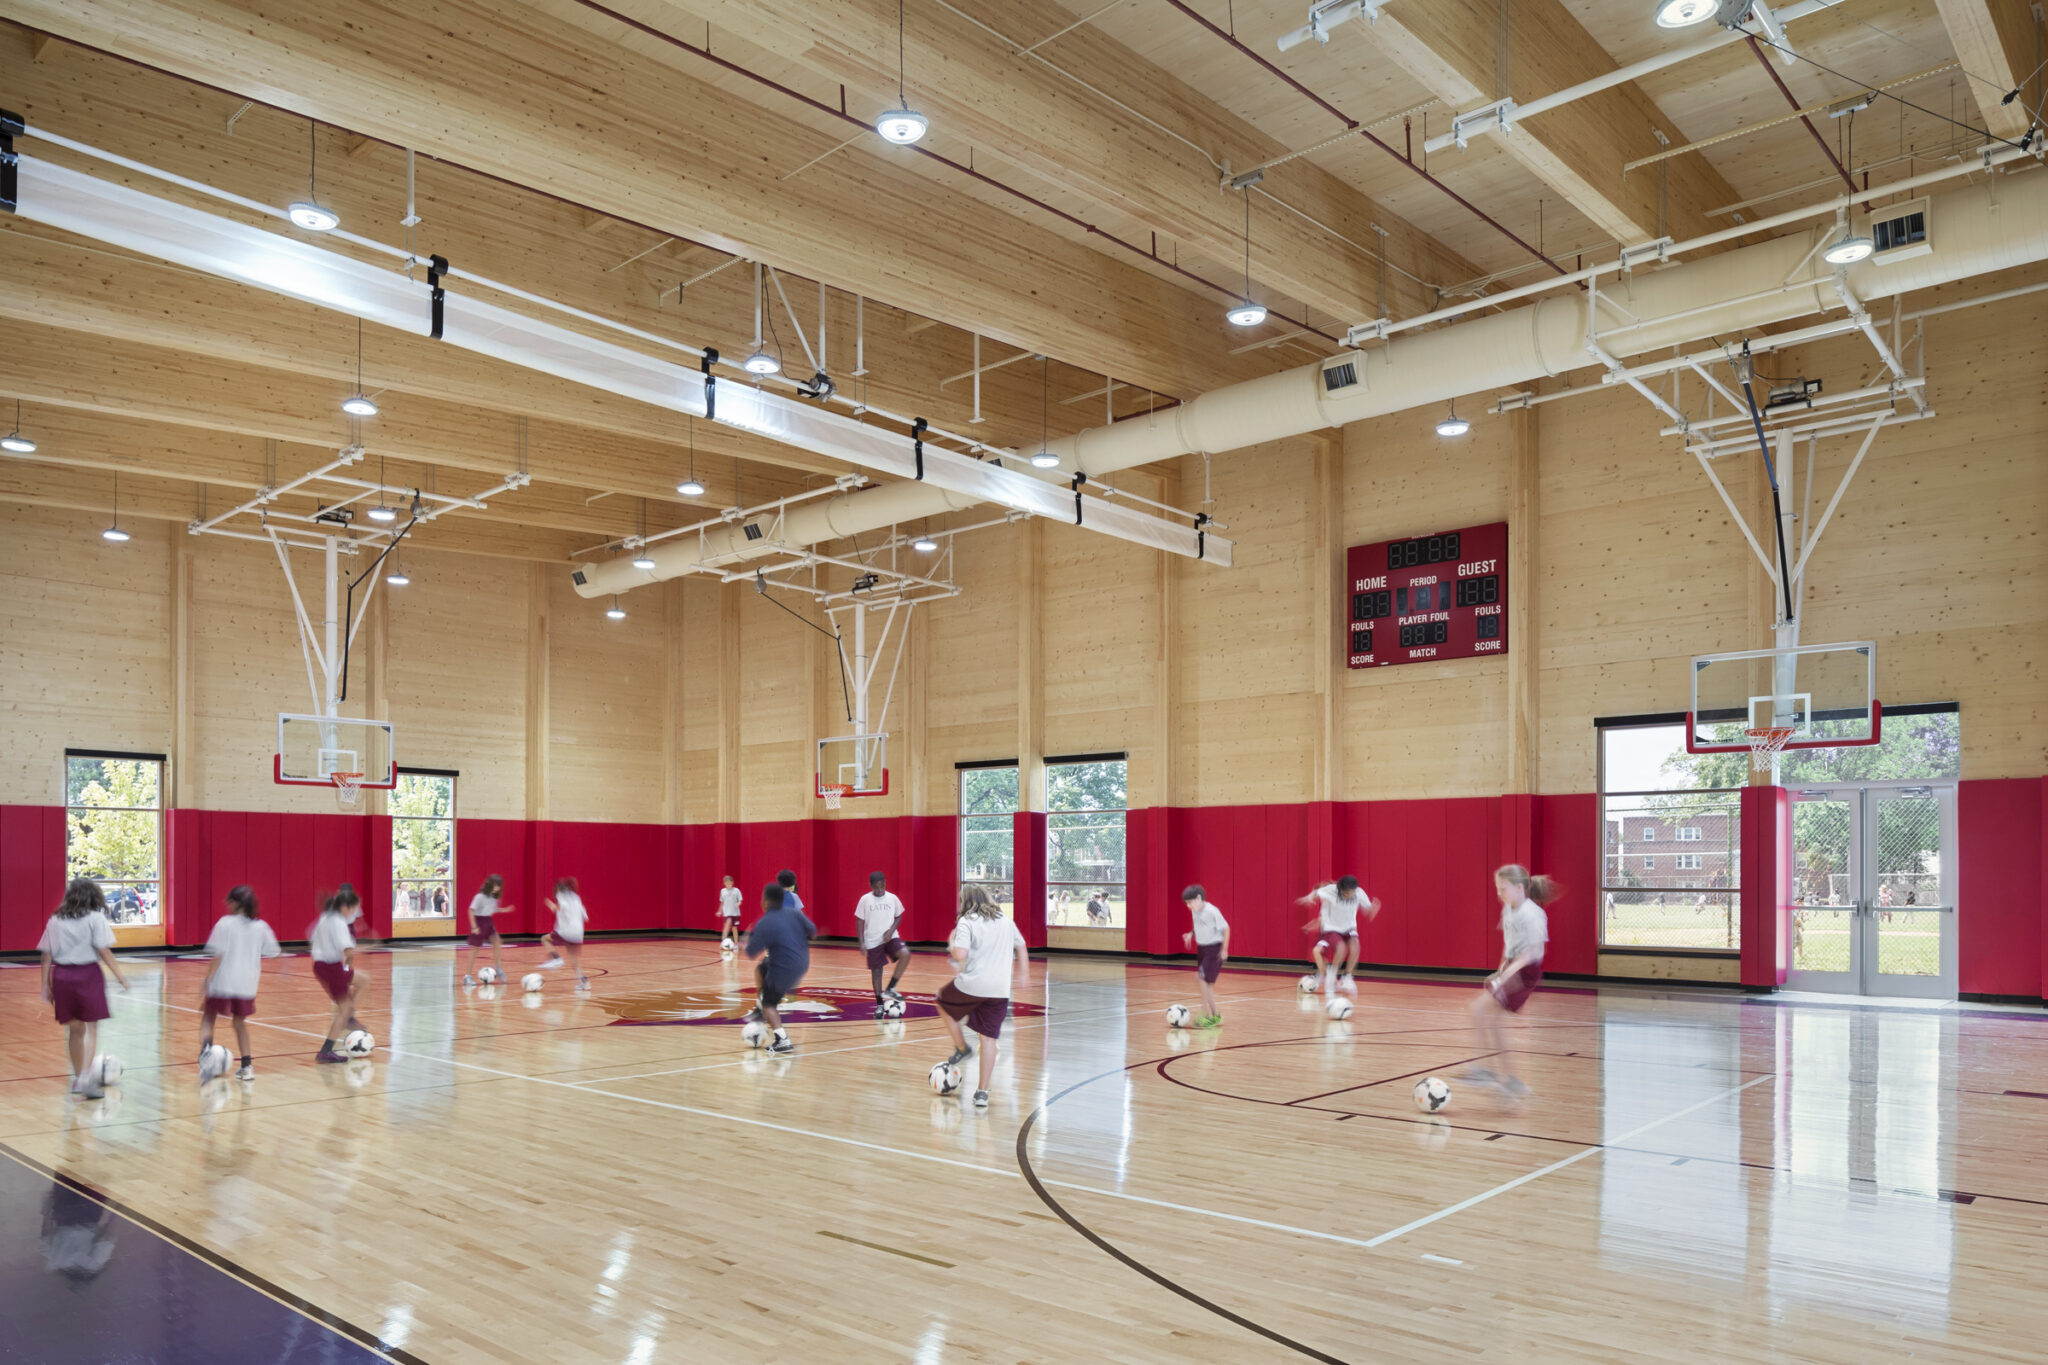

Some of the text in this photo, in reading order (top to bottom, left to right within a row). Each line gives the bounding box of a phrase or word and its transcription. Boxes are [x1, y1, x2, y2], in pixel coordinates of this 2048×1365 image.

[1458, 560, 1496, 576] GUEST
[1356, 576, 1387, 591] HOME
[1410, 576, 1437, 586] PERIOD
[1475, 605, 1501, 616] FOULS
[1399, 612, 1449, 625] PLAYER FOUL
[1351, 622, 1374, 631] FOULS
[1475, 641, 1501, 651] SCORE
[1410, 648, 1436, 658] MATCH
[1351, 655, 1374, 664] SCORE
[869, 903, 892, 912] LATIN
